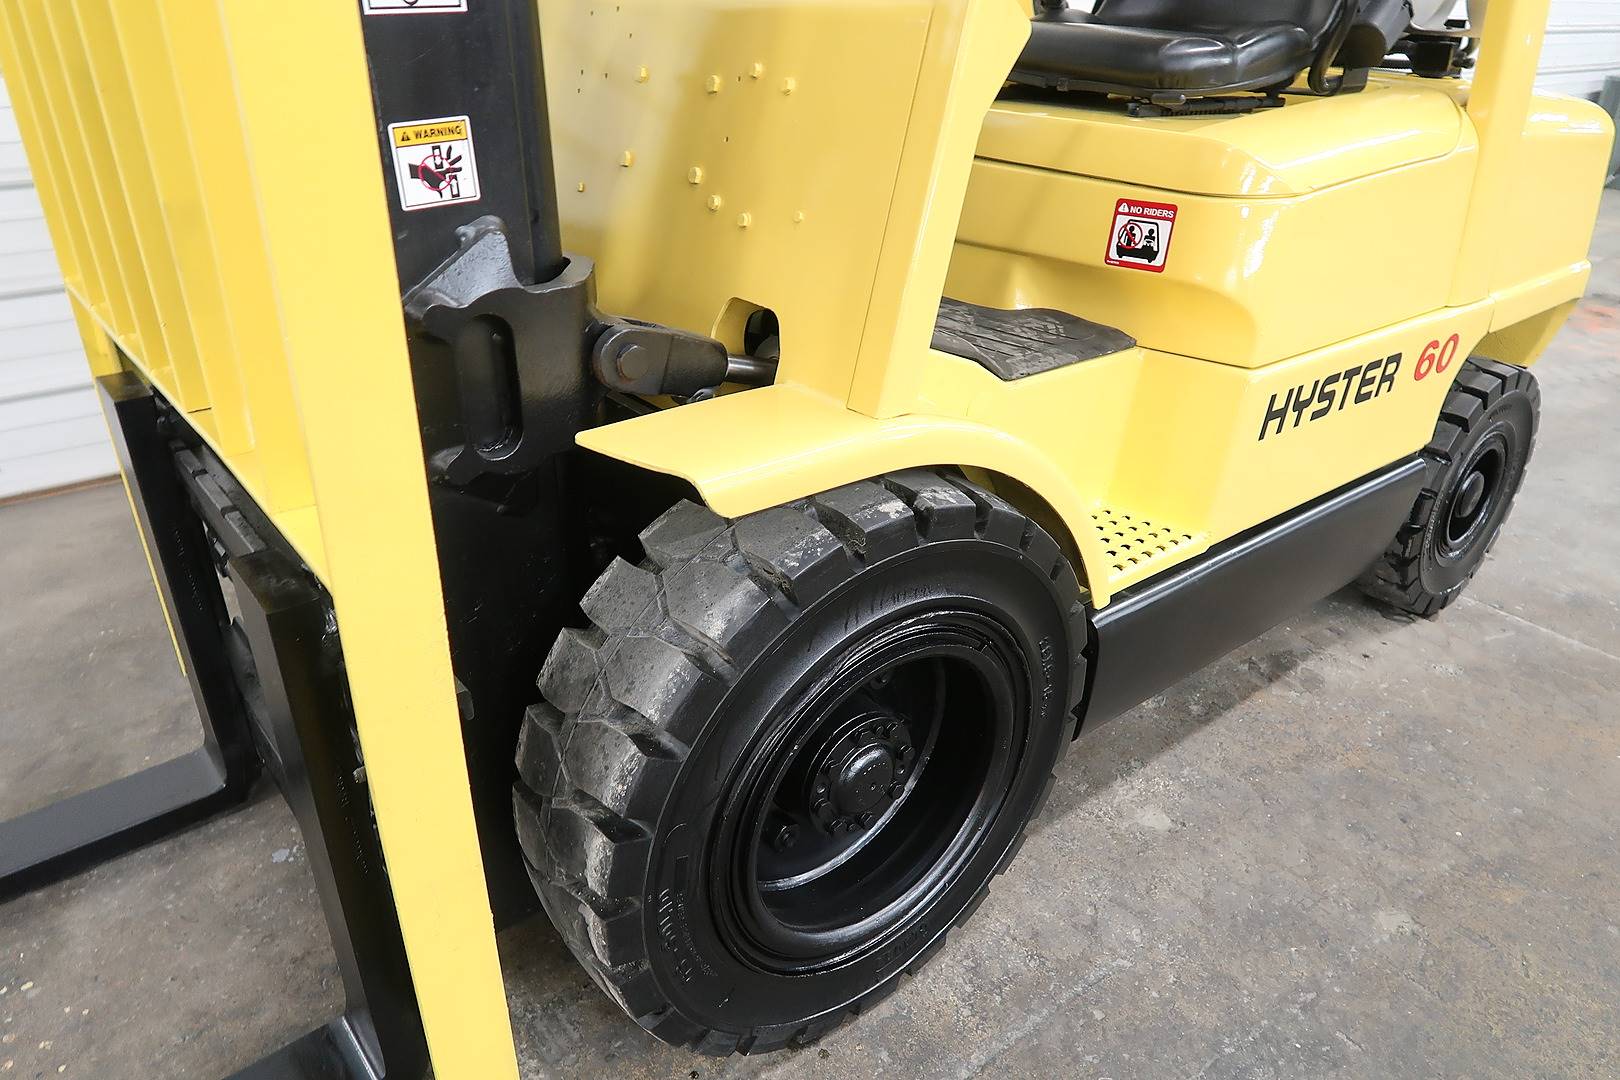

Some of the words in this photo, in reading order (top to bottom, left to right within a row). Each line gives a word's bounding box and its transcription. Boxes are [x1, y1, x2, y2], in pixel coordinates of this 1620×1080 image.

[413, 125, 463, 139] WARNING
[1129, 205, 1143, 214] NO
[1143, 207, 1175, 218] RIDERS
[1257, 352, 1403, 442] HYSTER
[1413, 333, 1460, 382] 60
